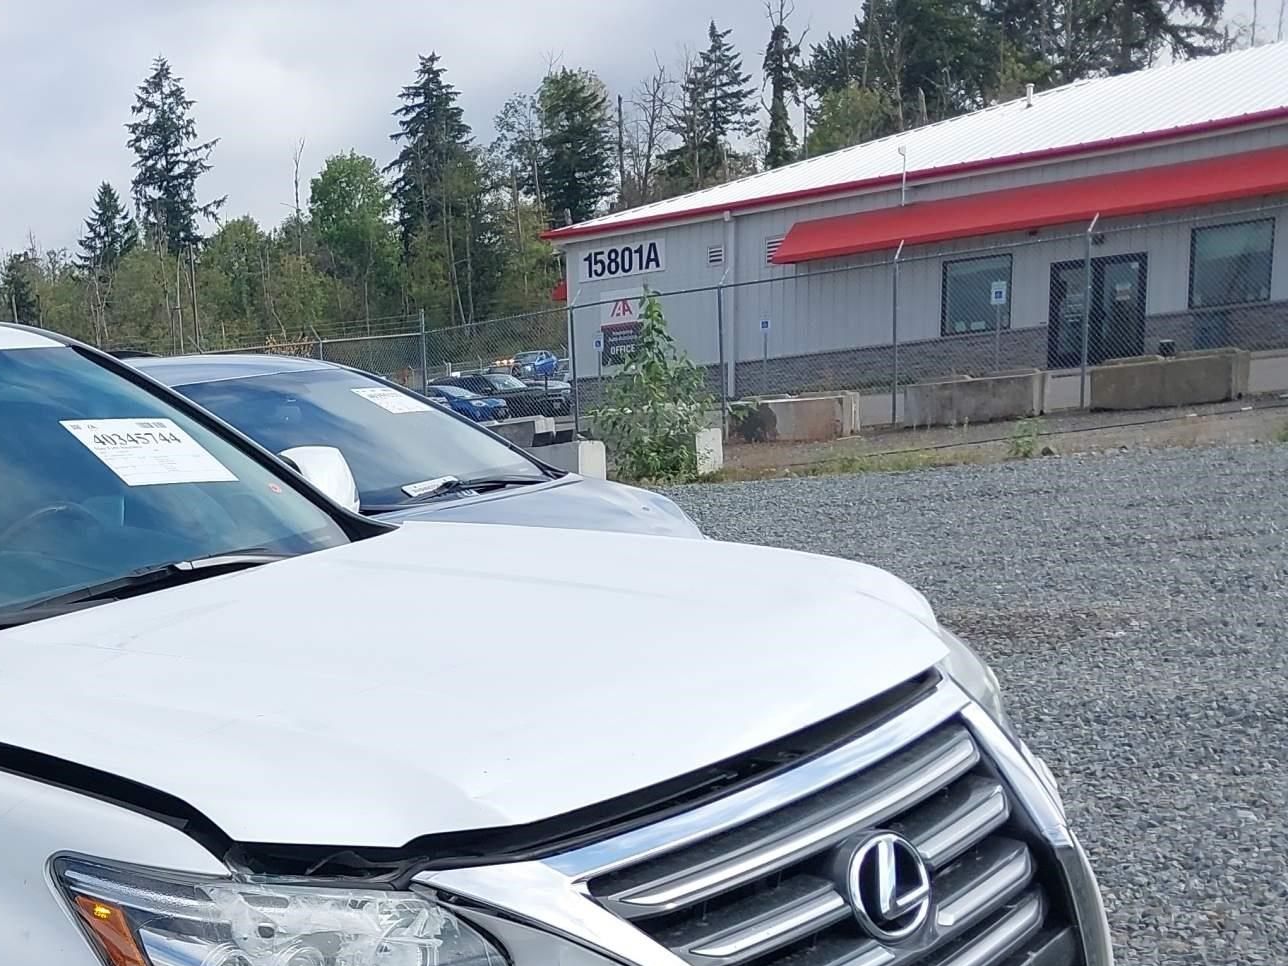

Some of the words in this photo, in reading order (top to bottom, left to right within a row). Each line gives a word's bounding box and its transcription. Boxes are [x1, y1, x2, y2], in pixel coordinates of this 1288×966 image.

[583, 241, 661, 279] 15801A
[610, 343, 636, 355] OFFICE
[93, 431, 182, 446] 40345744
